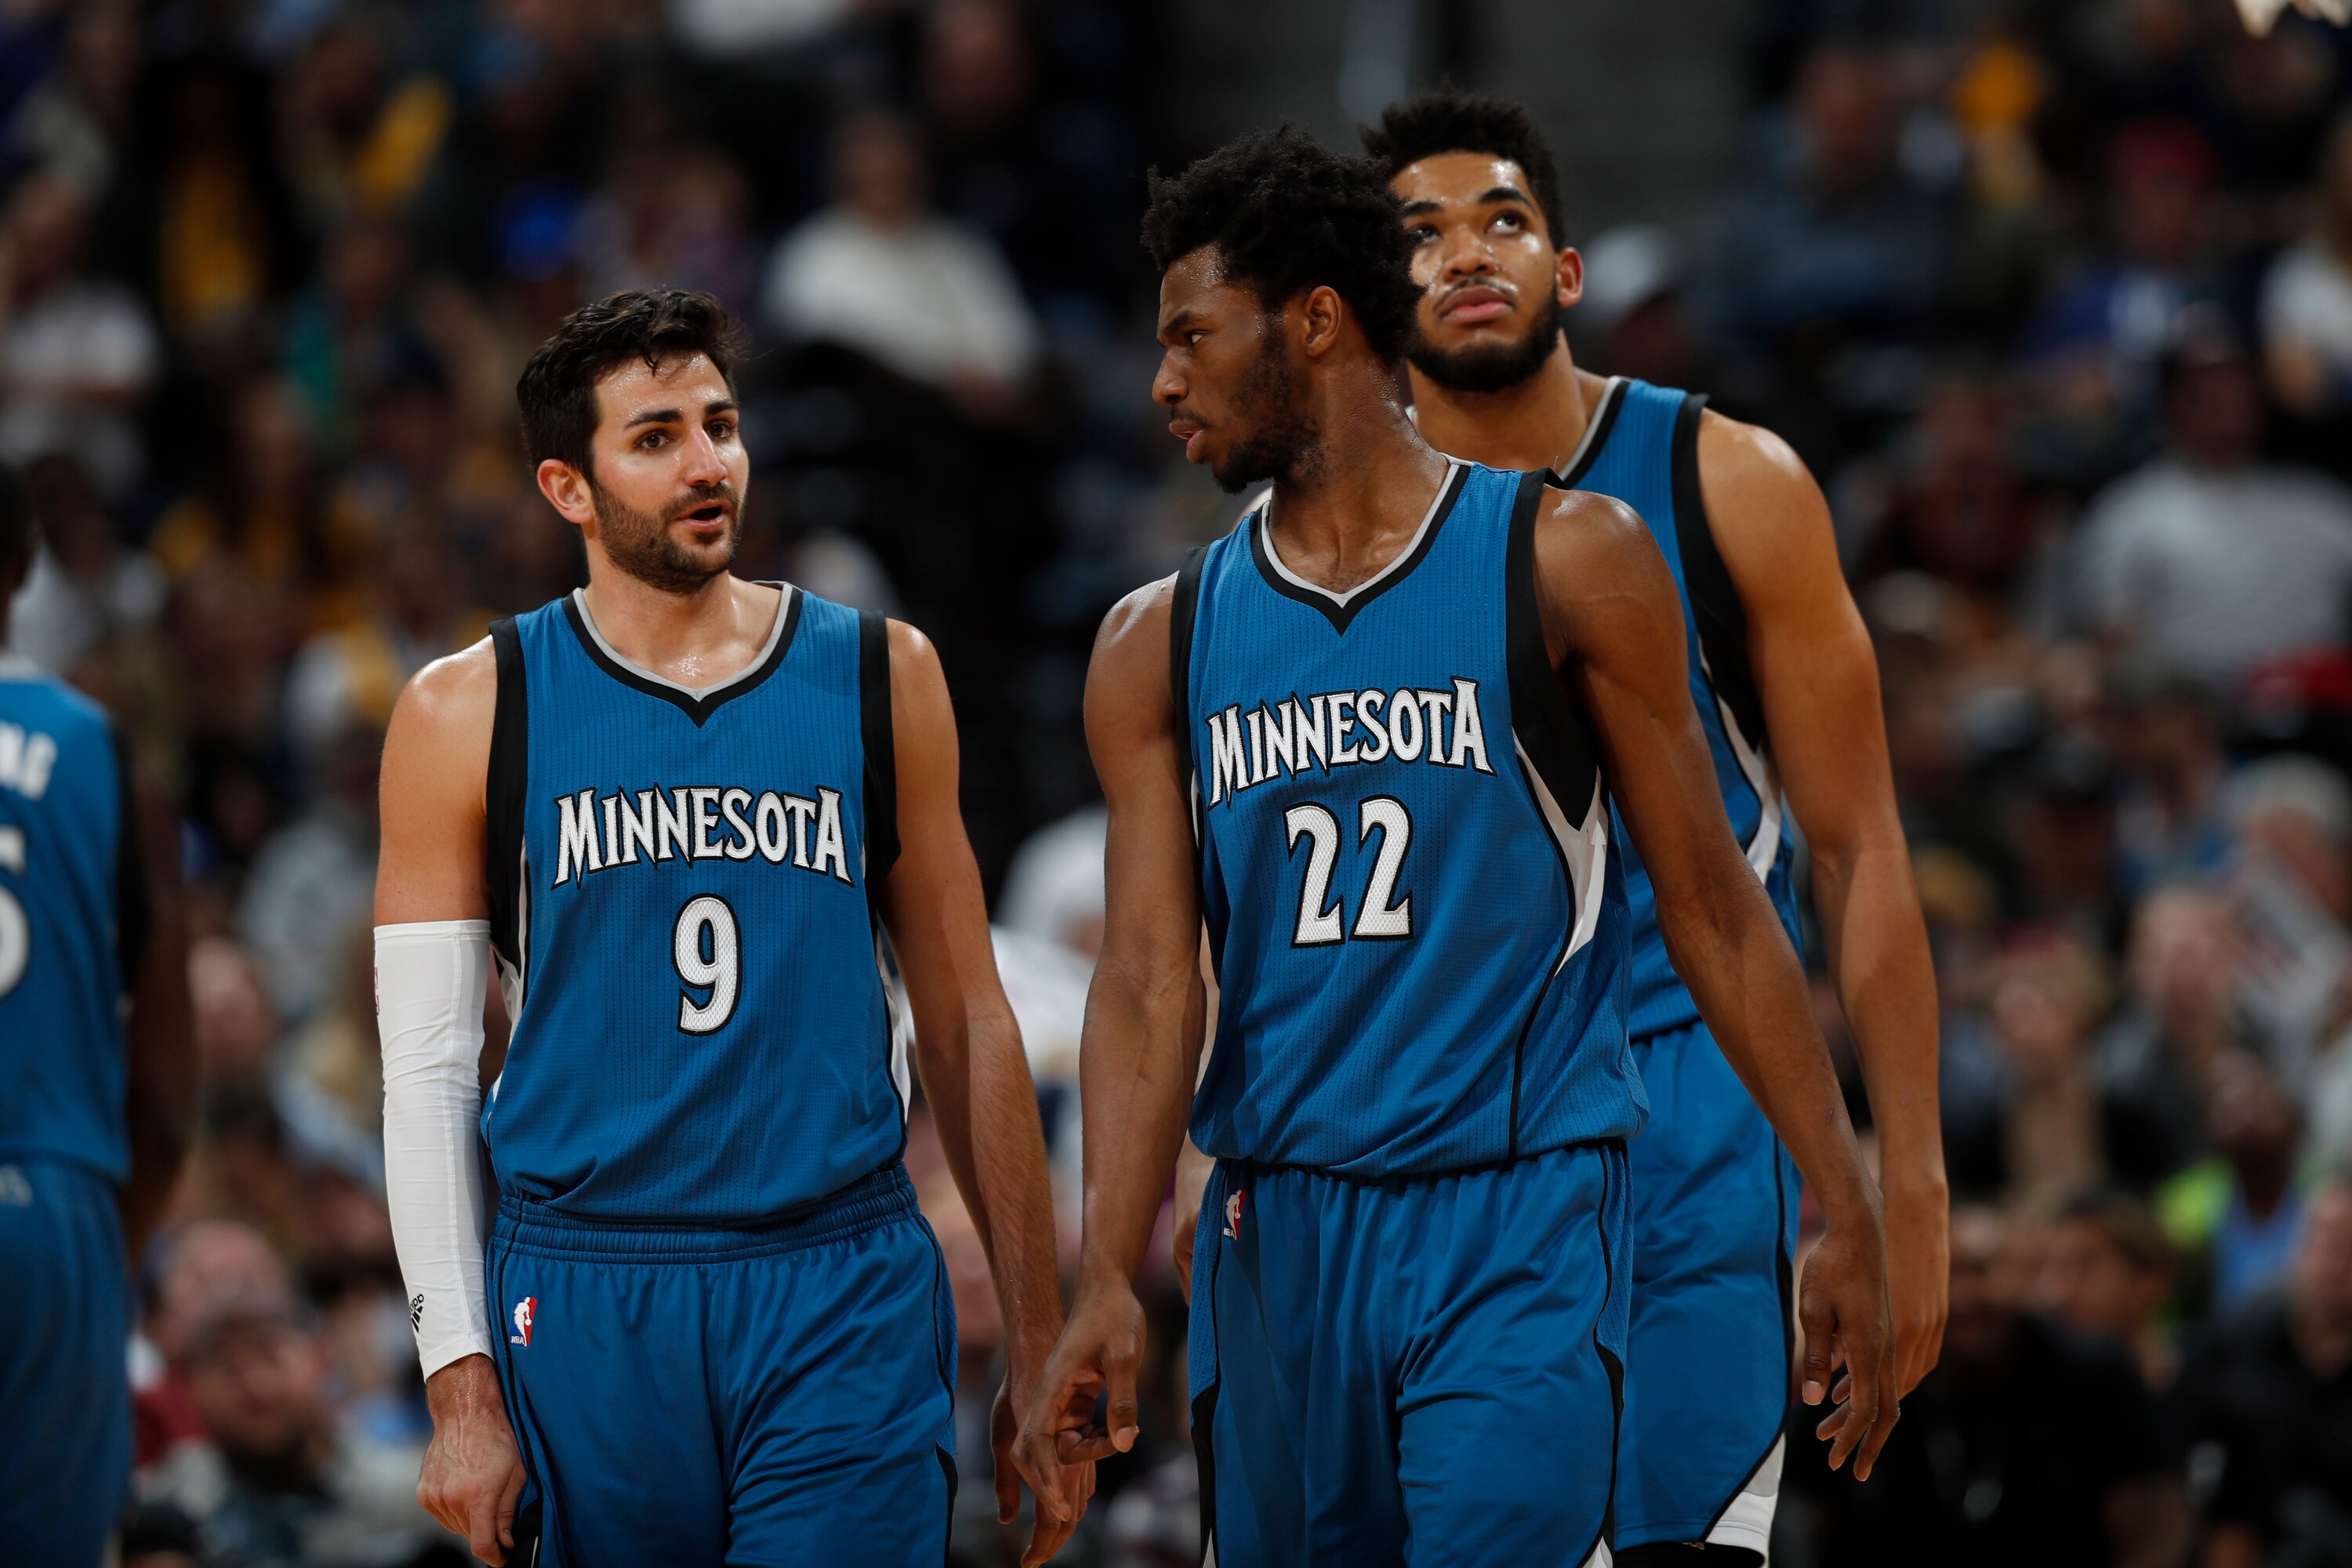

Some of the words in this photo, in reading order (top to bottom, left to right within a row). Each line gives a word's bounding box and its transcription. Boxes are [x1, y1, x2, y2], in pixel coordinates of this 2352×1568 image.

[1208, 675, 1497, 811] MINNESOTA
[551, 782, 855, 889] MINNESOTA
[1282, 794, 1414, 949] 22
[671, 893, 742, 1036] 9
[510, 1336, 524, 1345] NBA
